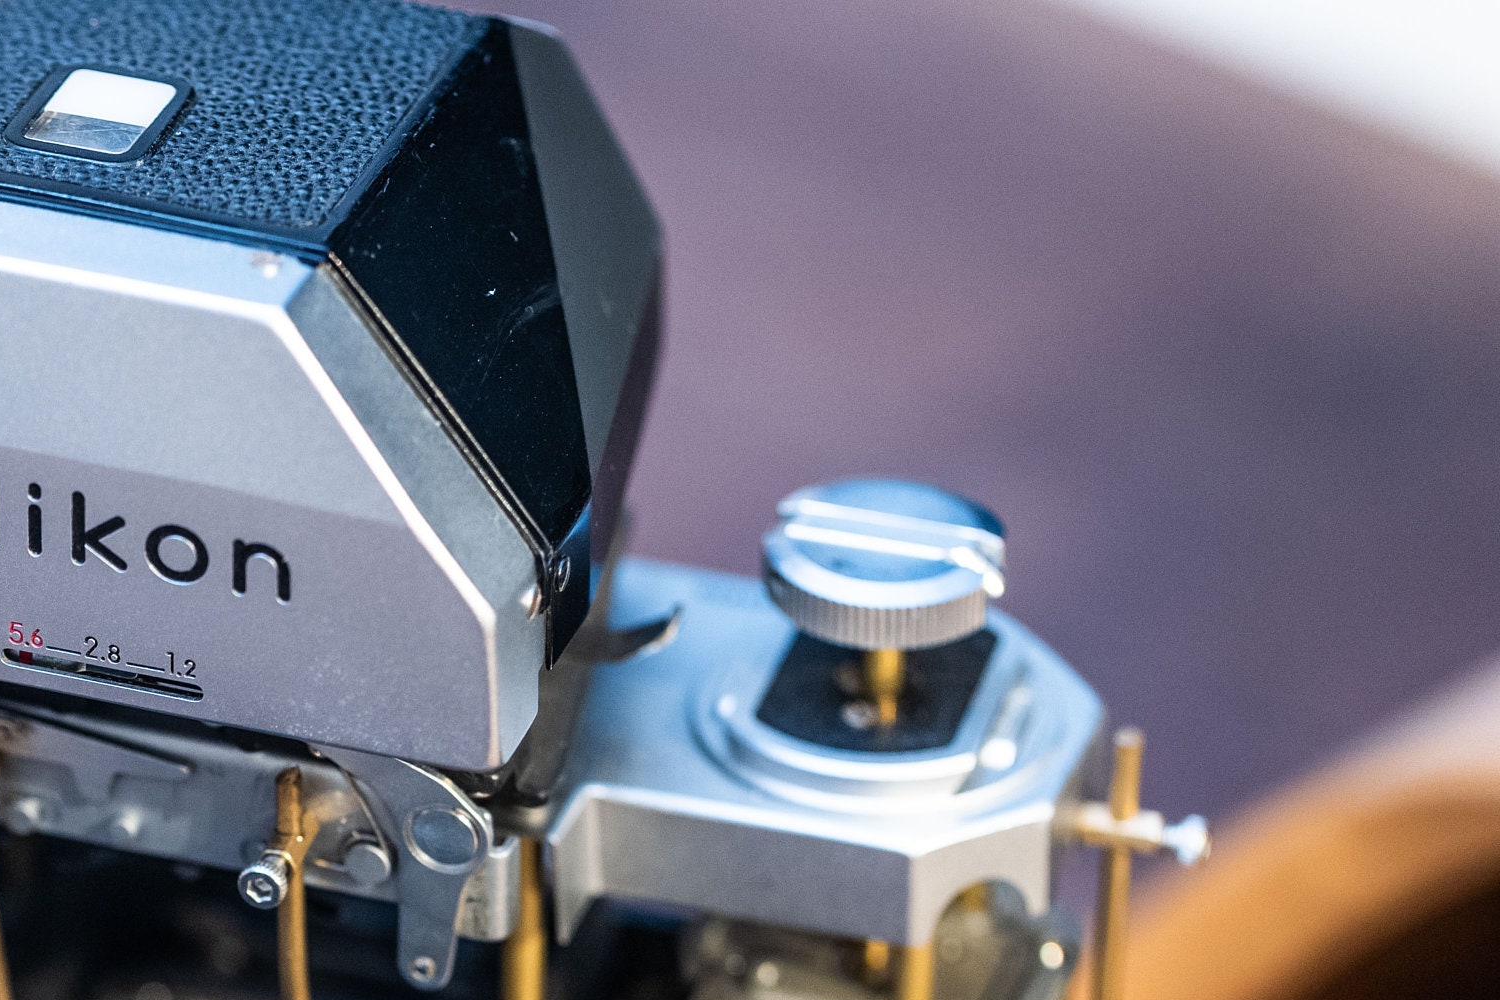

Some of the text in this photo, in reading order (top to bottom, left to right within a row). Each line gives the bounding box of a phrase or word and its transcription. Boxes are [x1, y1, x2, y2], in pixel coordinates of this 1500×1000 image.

[7, 621, 197, 679] 5.6 2.8 1.2
